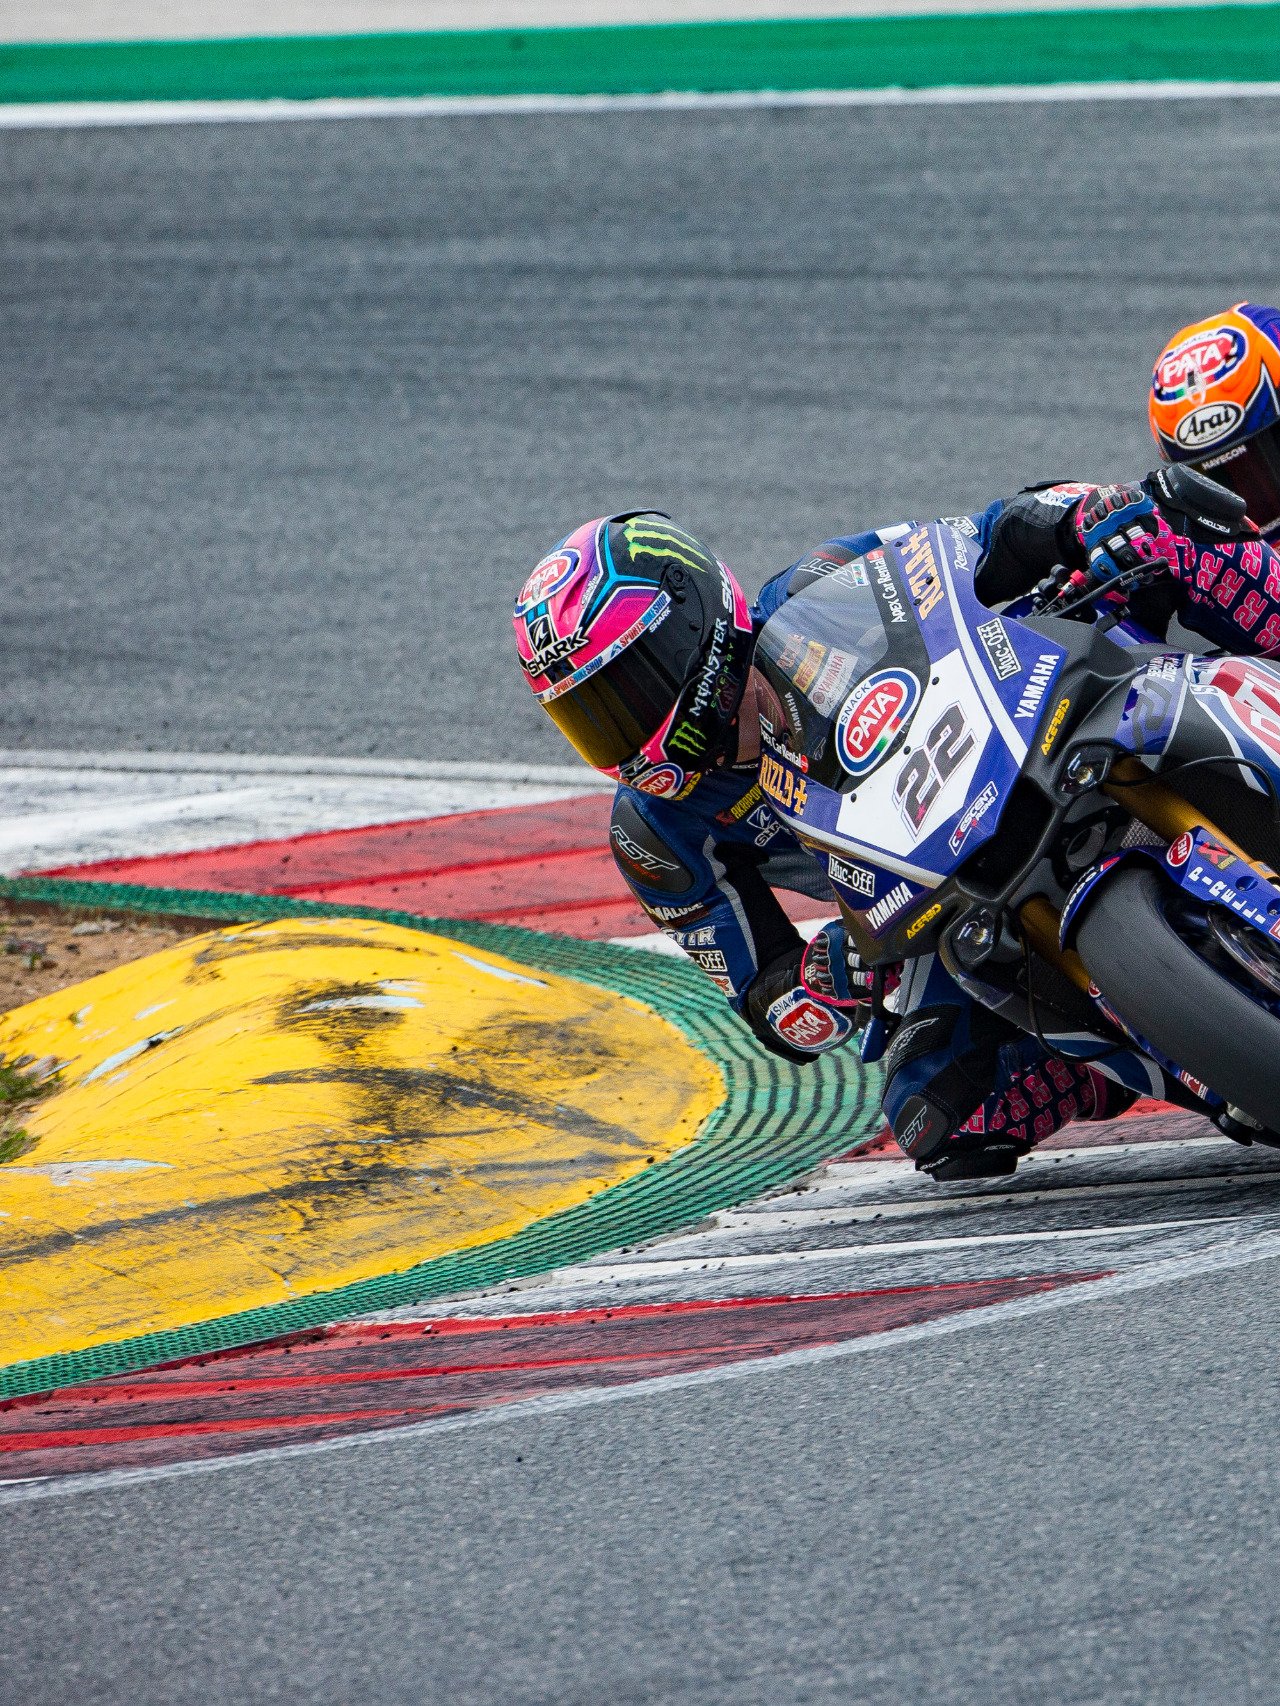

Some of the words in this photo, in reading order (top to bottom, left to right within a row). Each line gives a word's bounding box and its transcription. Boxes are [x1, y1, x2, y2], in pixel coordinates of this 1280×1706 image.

[1162, 344, 1222, 383] PATA
[1186, 408, 1232, 440] Arai
[869, 556, 890, 585] Rental
[882, 585, 897, 601] Car
[650, 606, 671, 633] SHARK
[528, 634, 589, 675] SHARK
[689, 618, 727, 717] MONSTER
[840, 682, 871, 725] SNACK
[1014, 653, 1060, 719] YAMAHA
[848, 690, 899, 752] PATA
[897, 703, 979, 840] 22
[611, 825, 680, 870] RST
[865, 882, 913, 930] YAMAHA
[1188, 867, 1266, 924] PIRELLI
[783, 1010, 828, 1044] PATA
